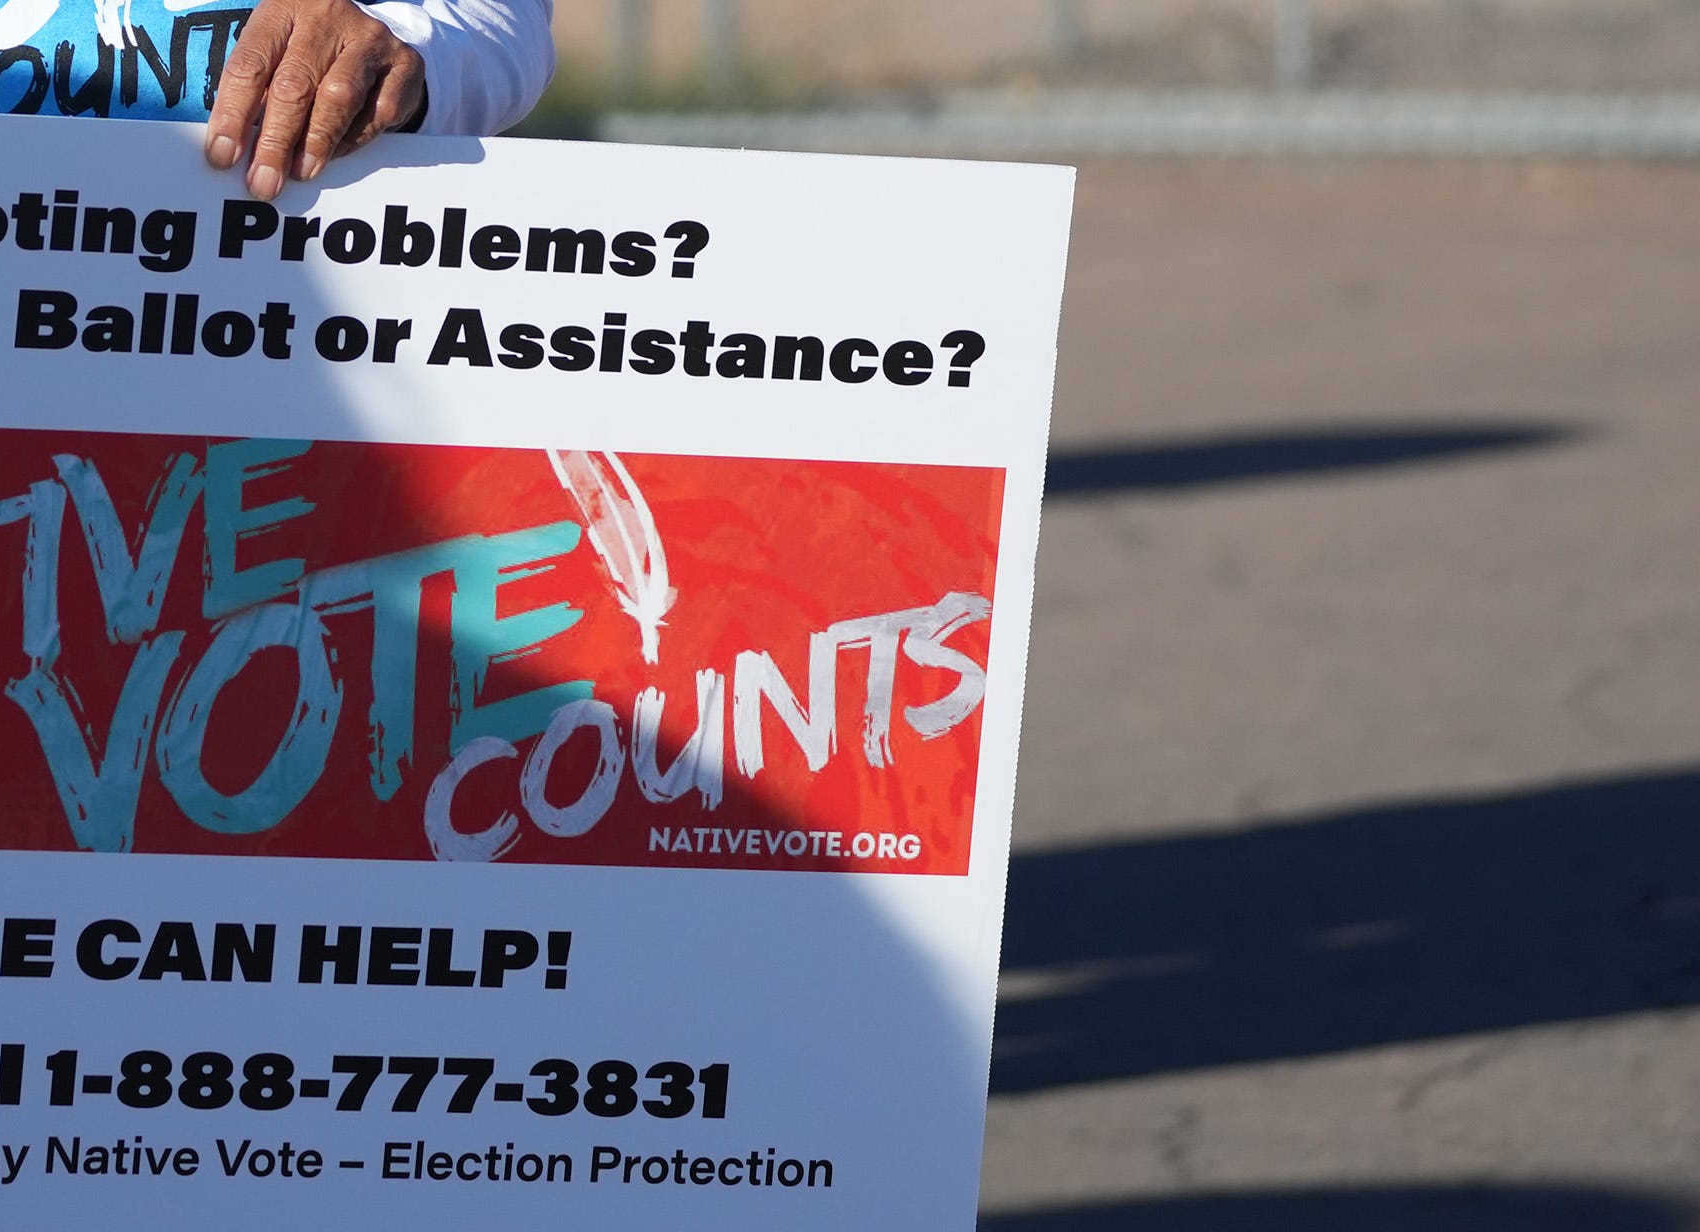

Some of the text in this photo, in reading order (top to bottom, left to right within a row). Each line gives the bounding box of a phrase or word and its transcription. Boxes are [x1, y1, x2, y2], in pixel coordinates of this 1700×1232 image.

[218, 199, 711, 280] Problems?
[14, 289, 295, 361] Ballot
[315, 314, 411, 365] or
[428, 308, 987, 388] Assistance?
[6, 521, 595, 854] VOTE
[424, 592, 993, 862] COUNTS
[648, 827, 922, 862] NATIVEVOTE.ORG
[76, 919, 277, 983] CAN
[298, 924, 573, 990] HELP!
[44, 1049, 730, 1119] 1-888-777-3831
[44, 1135, 200, 1176] Native
[215, 1139, 323, 1179] Vote
[381, 1142, 574, 1183] Election
[590, 1146, 835, 1188] Protection
